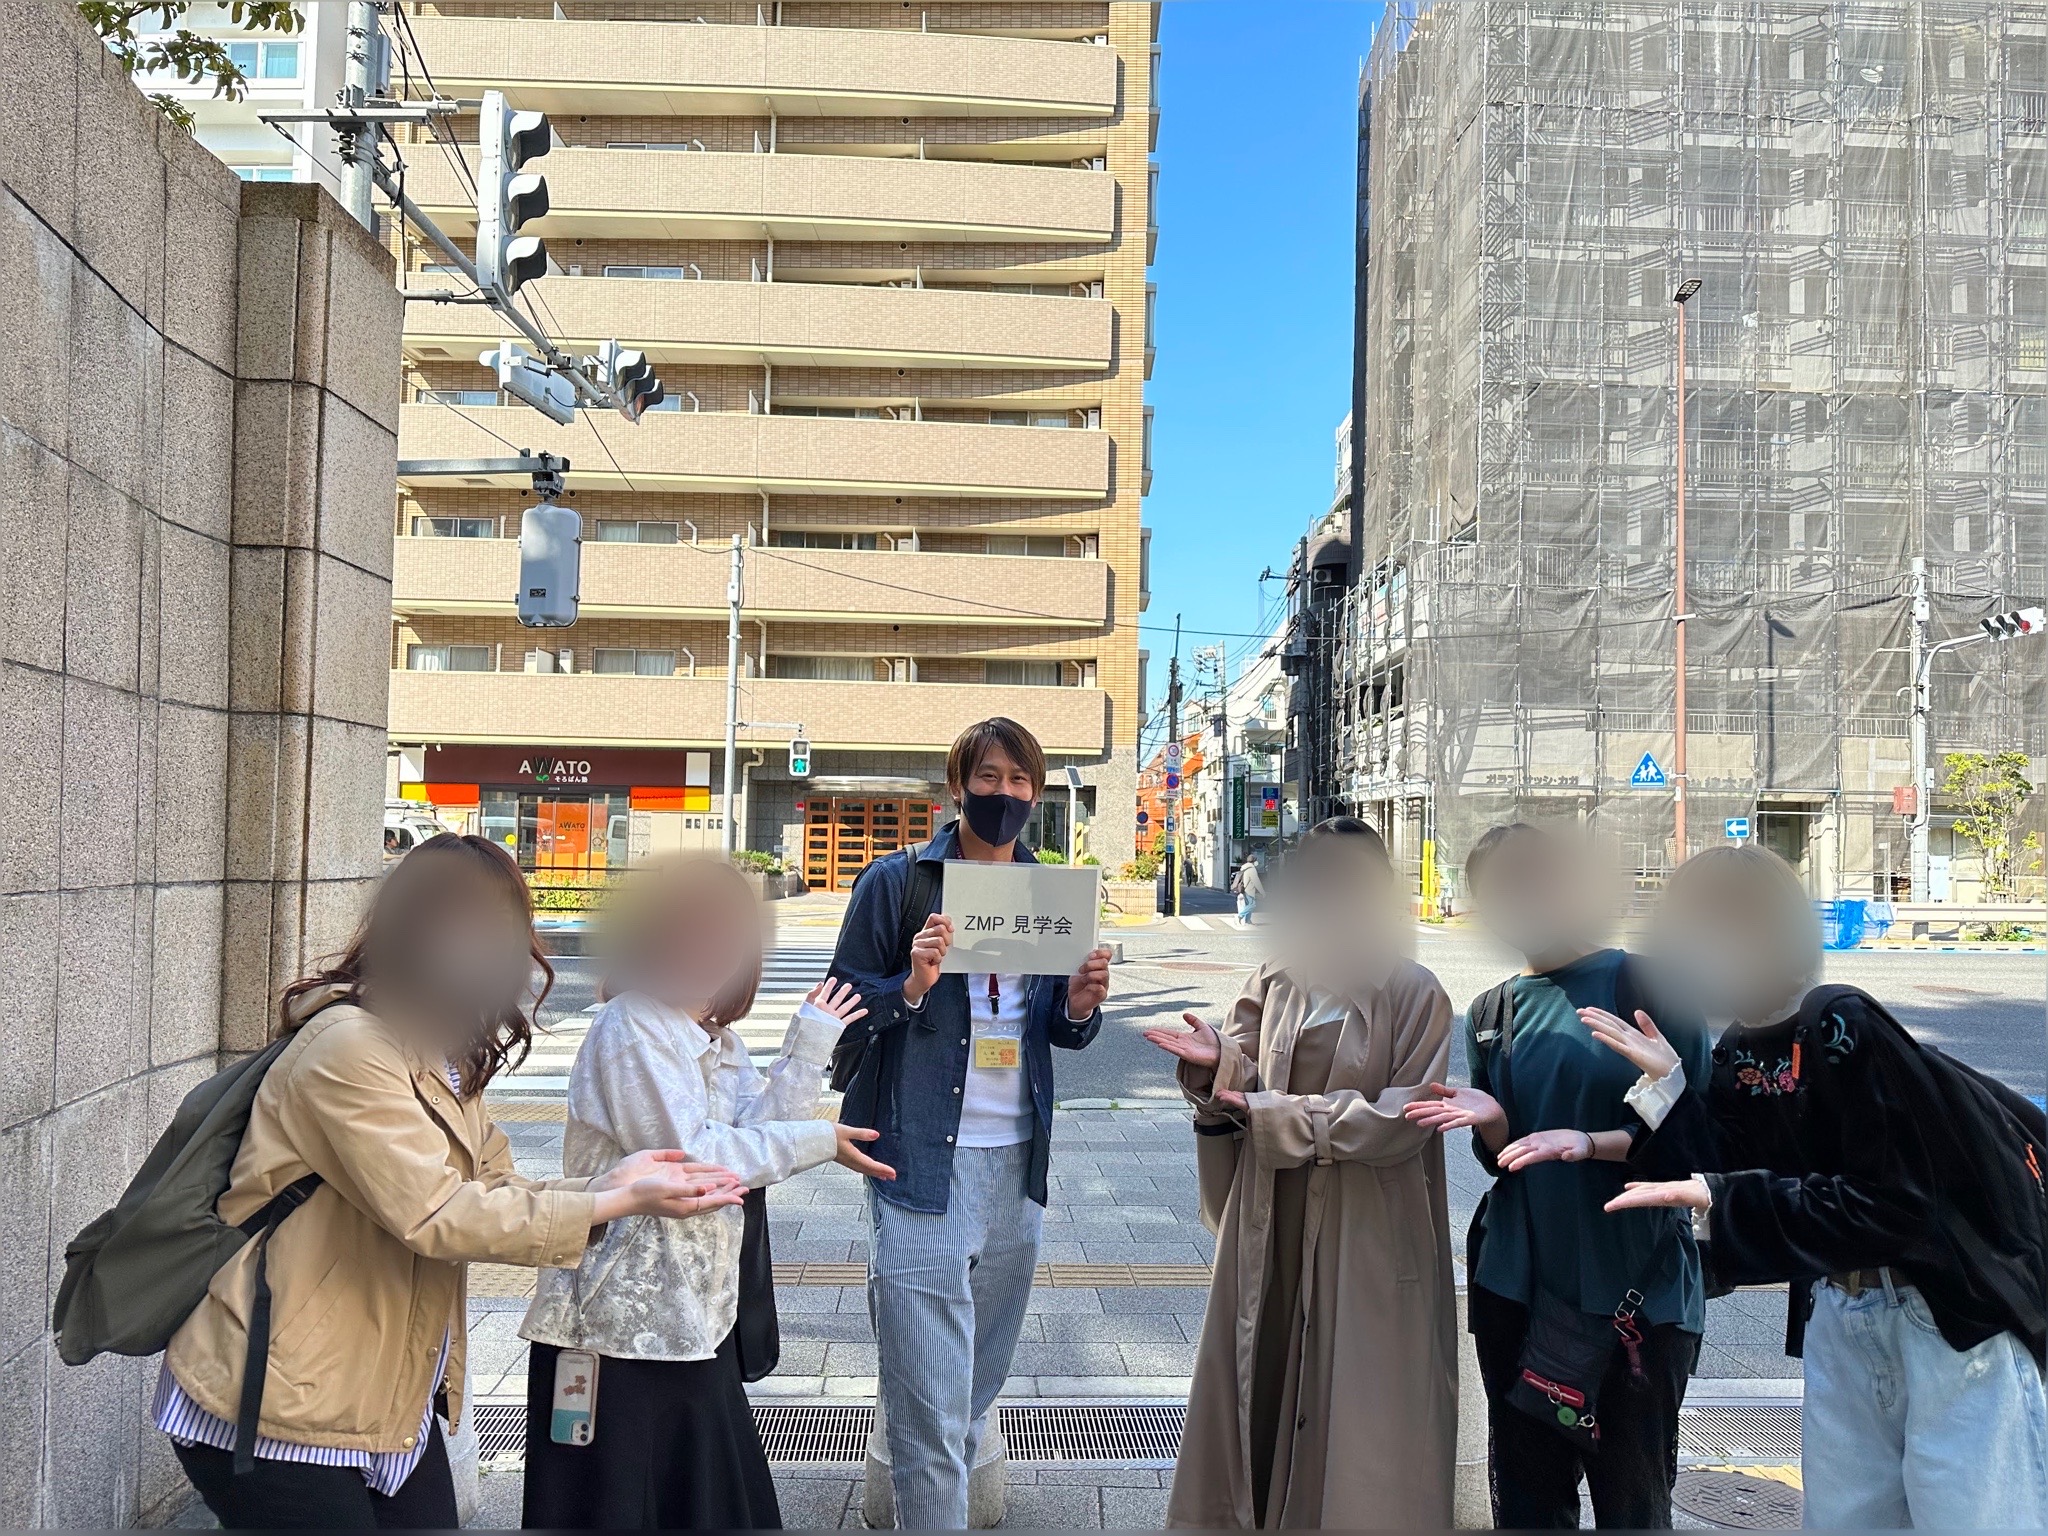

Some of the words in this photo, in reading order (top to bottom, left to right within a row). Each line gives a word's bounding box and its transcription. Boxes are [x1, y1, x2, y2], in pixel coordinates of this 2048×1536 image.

[518, 757, 591, 775] AWATO
[554, 775, 588, 783] そろばん塾
[558, 821, 586, 829] AWATO
[964, 915, 1005, 931] ZMP
[1011, 915, 1073, 935] 見学会
